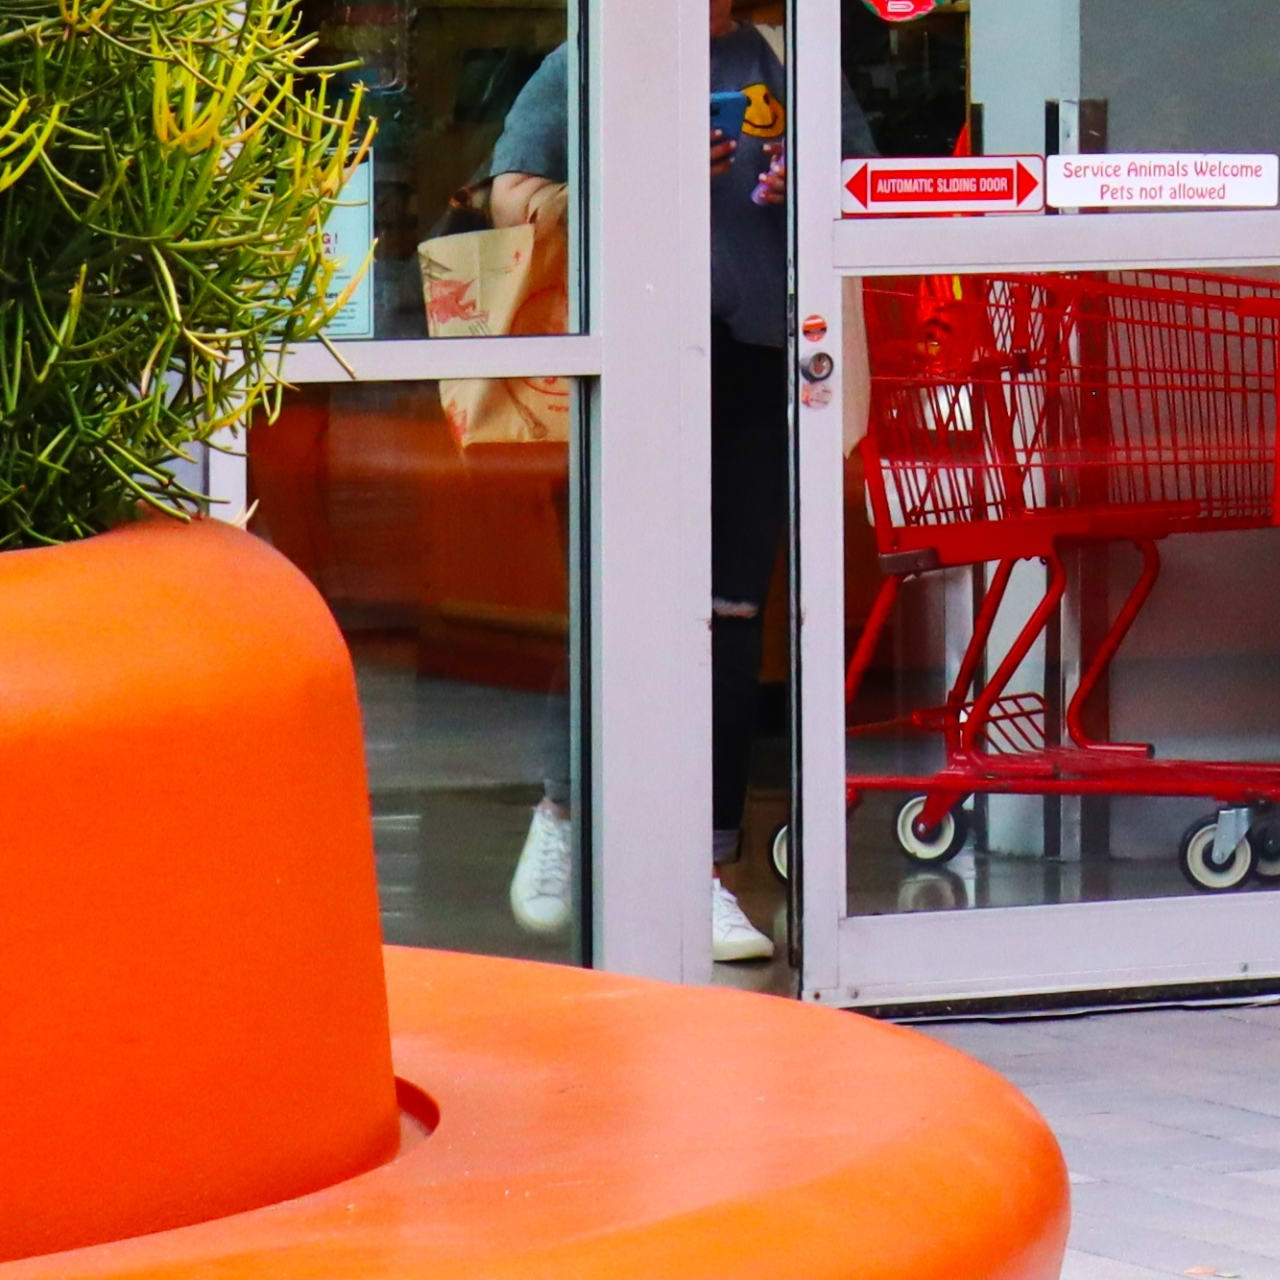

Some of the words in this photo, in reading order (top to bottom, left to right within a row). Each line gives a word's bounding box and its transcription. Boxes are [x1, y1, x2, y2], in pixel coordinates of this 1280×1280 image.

[1063, 162, 1122, 178] Service
[1127, 161, 1189, 177] Animals
[1194, 160, 1263, 178] Welcome
[877, 178, 934, 193] AUTOMATIC
[937, 177, 977, 192] SLIDING
[979, 177, 1008, 192] DOOR
[1100, 184, 1134, 200] Pets
[1139, 184, 1164, 200] not
[1170, 184, 1226, 200] allowed
